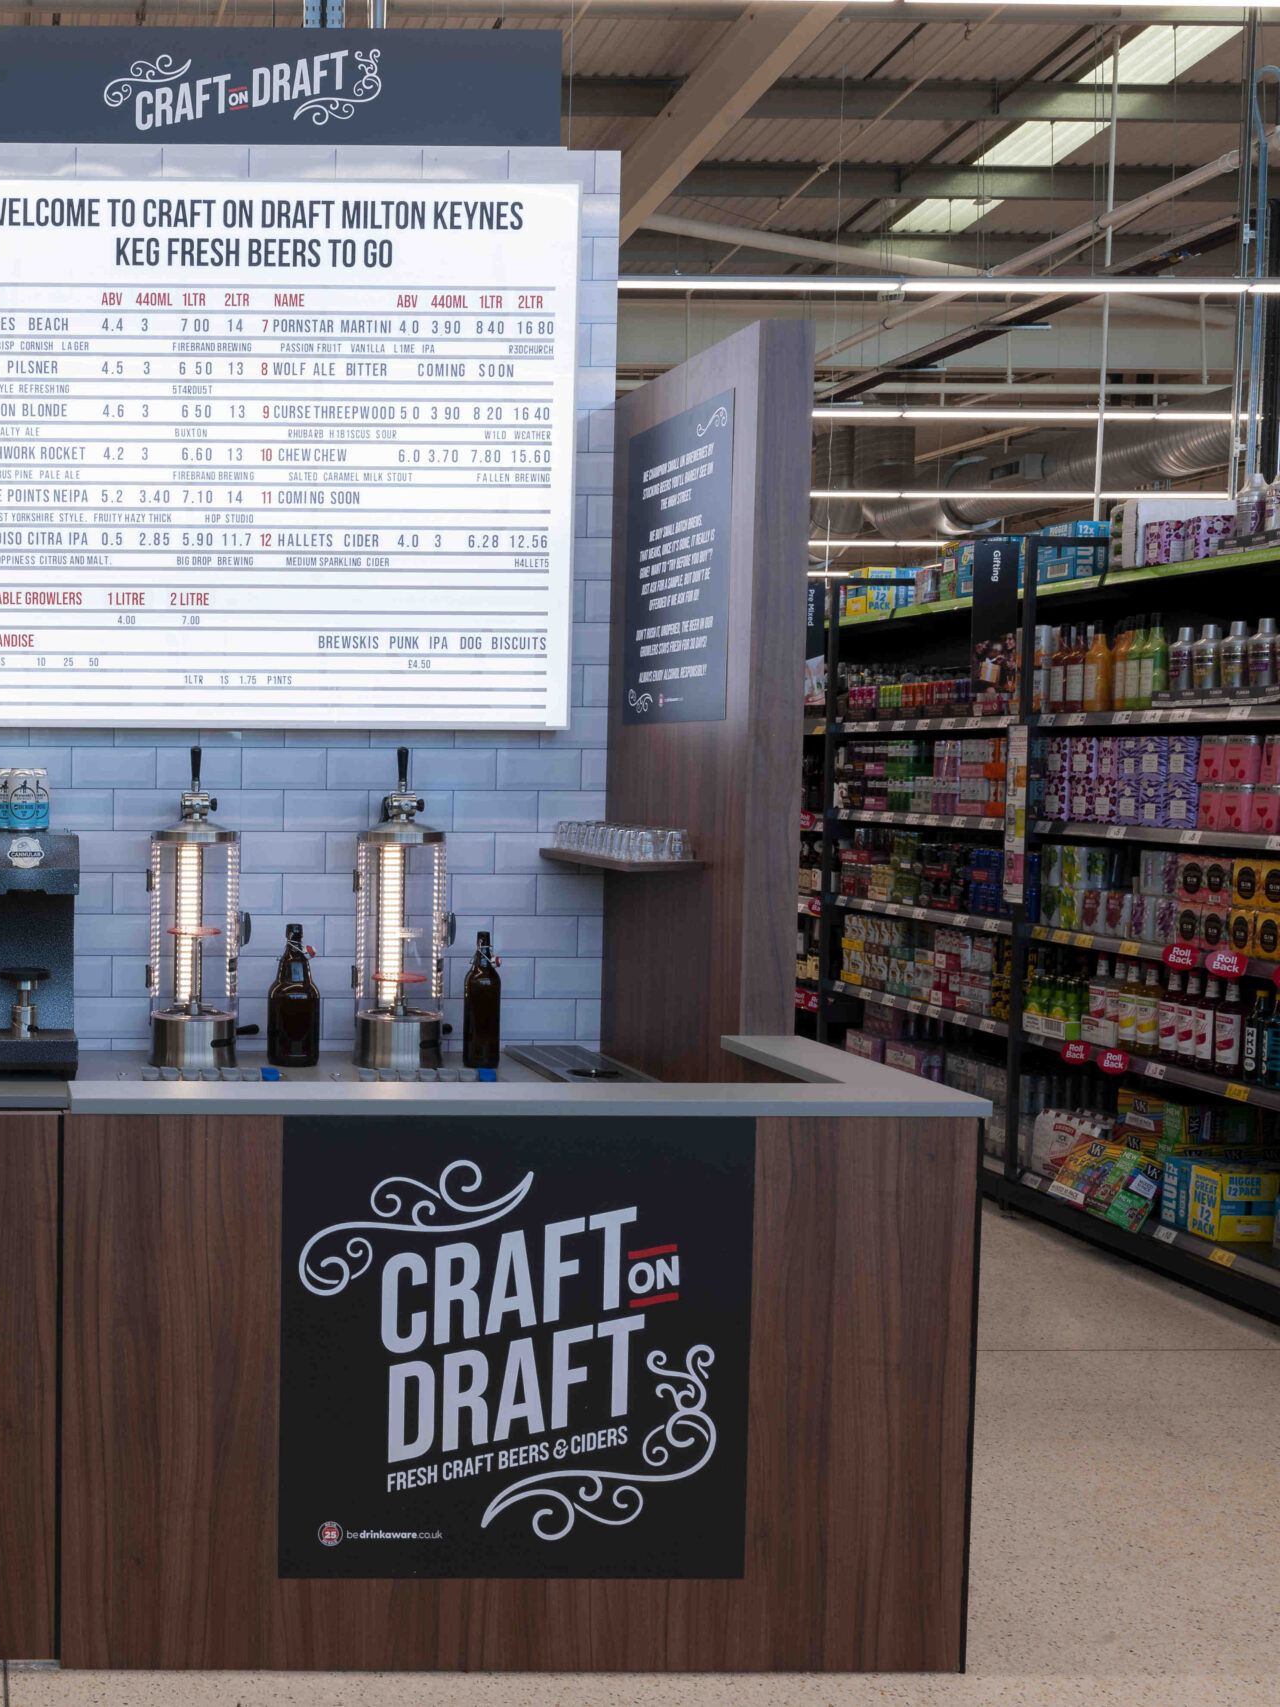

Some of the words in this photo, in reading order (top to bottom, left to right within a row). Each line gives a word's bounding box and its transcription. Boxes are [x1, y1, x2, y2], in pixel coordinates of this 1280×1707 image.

[136, 74, 231, 130] CRAFT
[228, 90, 248, 106] ON
[252, 50, 348, 108] DRAFT
[106, 198, 136, 227] TO
[143, 198, 218, 228] CRAFT
[223, 199, 253, 228] ON
[262, 199, 335, 228] DRAFT
[341, 199, 426, 228] MILTON
[432, 199, 524, 229] KEYNES
[115, 238, 160, 267] KEG
[167, 238, 240, 267] FRESH
[248, 238, 322, 267] BEERS
[328, 239, 356, 267] TO
[364, 239, 392, 267] GO
[101, 292, 122, 306] ABV
[136, 292, 173, 307] 440ML
[182, 293, 206, 307] 1LTR
[224, 293, 250, 307] 2LTR
[274, 293, 304, 308] NAME
[396, 294, 418, 308] ABV
[430, 294, 468, 309] 440ML
[479, 295, 503, 309] 1LTR
[518, 295, 543, 309] 2LTR
[28, 317, 70, 332] BEACH
[272, 320, 334, 334] PORNSTAR
[340, 320, 392, 334] MARTINI
[20, 341, 54, 351] CORNISH
[61, 341, 90, 351] LAGER
[7, 360, 58, 374] PILSNER
[272, 362, 306, 377] WOLF
[312, 363, 336, 377] ALE
[346, 363, 388, 377] BITTER
[417, 363, 466, 378] COMING
[478, 364, 514, 378] SOON
[22, 403, 68, 417] BLONDE
[273, 406, 311, 419] CURSE
[314, 406, 396, 420] THREEPWOOD
[40, 446, 86, 460] ROCKET
[278, 448, 311, 462] CHEW
[314, 448, 348, 462] CHEW
[7, 489, 50, 502] POINTS
[53, 489, 88, 502] NEIPA
[278, 491, 325, 505] COMING
[330, 491, 360, 505] SOON
[11, 513, 55, 523] YORKSHIRE
[27, 532, 63, 546] CITRA
[68, 532, 88, 546] IPA
[277, 534, 333, 548] HALLETS
[344, 534, 380, 548] CIDER
[286, 557, 318, 567] MEDIUM
[319, 557, 362, 567] SPARKLING
[366, 557, 390, 567] CIDER
[992, 550, 1001, 582] Gifting
[24, 592, 83, 606] GROWLERS
[116, 592, 146, 606] LITRE
[170, 593, 178, 606] 2
[180, 593, 210, 606] LITRE
[318, 636, 380, 649] BREWSKIS
[389, 636, 420, 650] PUNK
[428, 636, 448, 650] IPA
[459, 636, 482, 650] DOG
[491, 637, 547, 650] BISCUITS
[408, 659, 431, 670] £4.50
[1172, 947, 1191, 958] Roll
[1216, 954, 1238, 965] Roll
[1168, 954, 1192, 966] Back
[1212, 961, 1240, 973] Back
[1200, 1208, 1212, 1222] 12
[1192, 1218, 1214, 1236] PACK
[381, 1206, 638, 1354] CRAFT
[628, 1255, 680, 1294] ON
[388, 1314, 646, 1464] DRAFT
[387, 1461, 438, 1493] FRESH
[442, 1450, 494, 1482] CRAFT
[498, 1440, 550, 1470] BEERS
[554, 1438, 568, 1460] &
[570, 1426, 628, 1455] CIDERS
